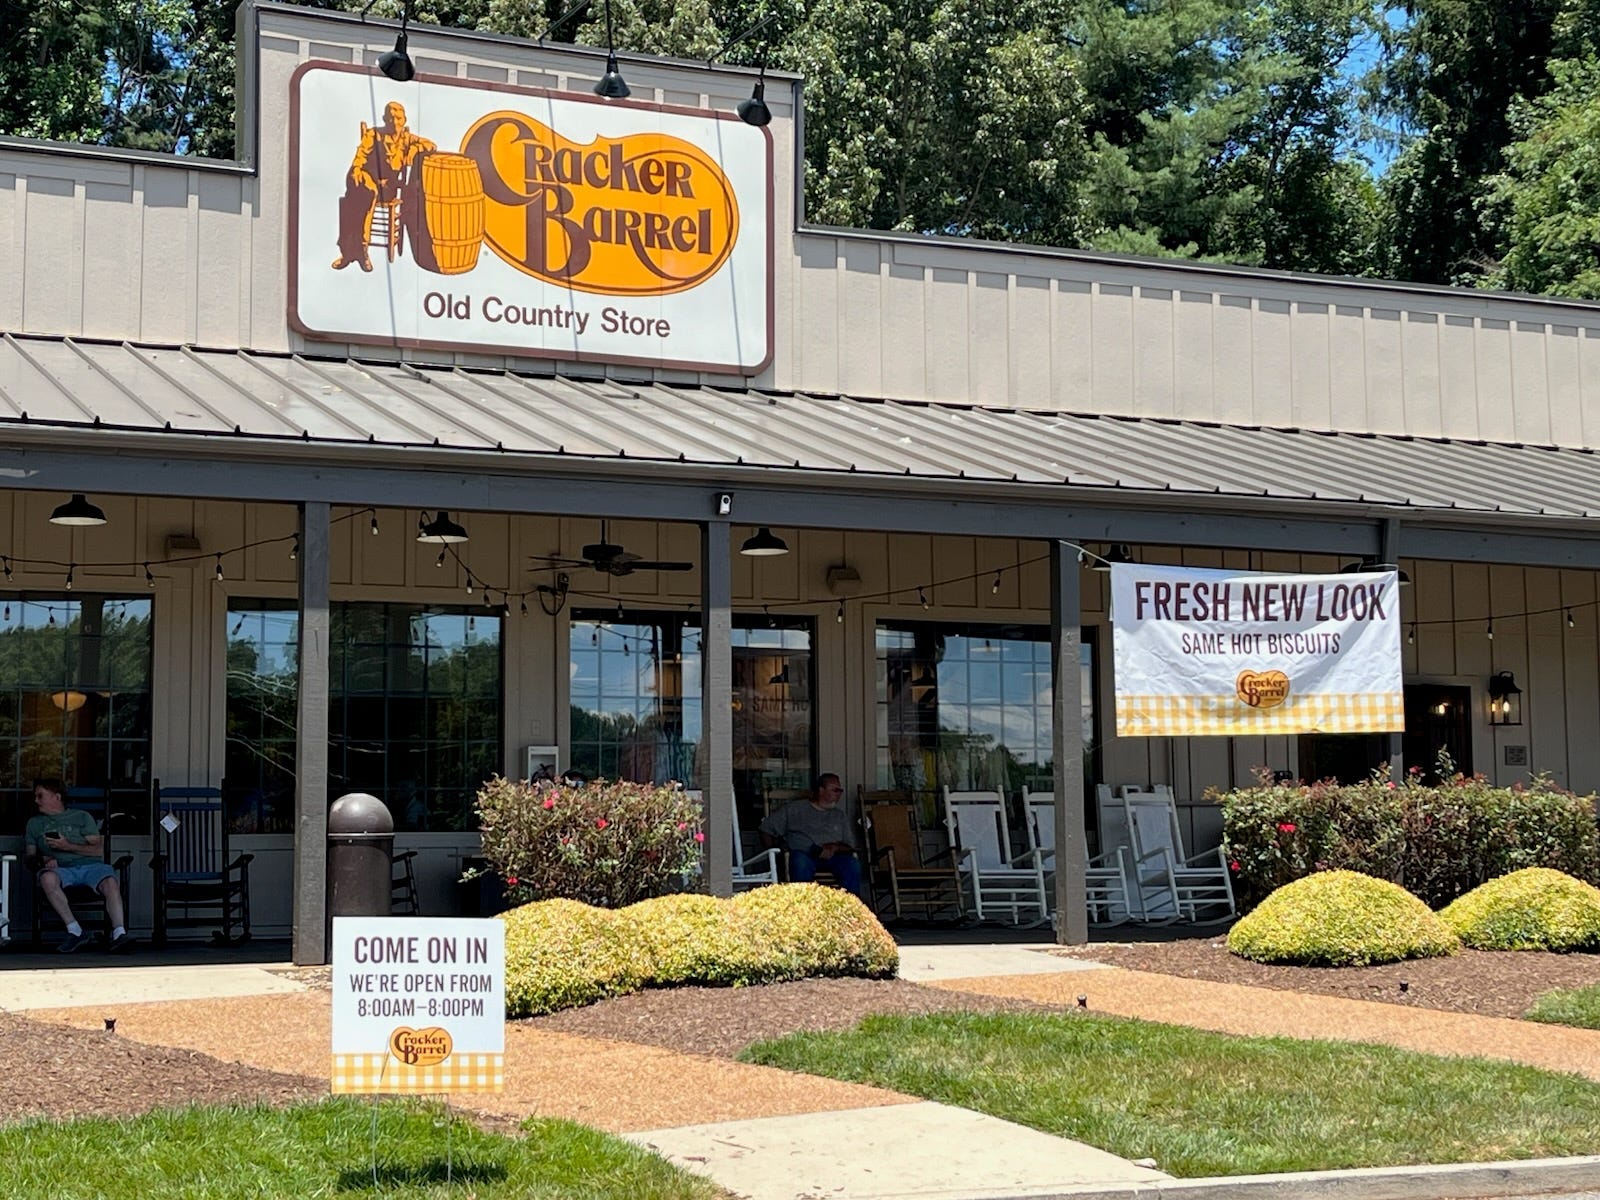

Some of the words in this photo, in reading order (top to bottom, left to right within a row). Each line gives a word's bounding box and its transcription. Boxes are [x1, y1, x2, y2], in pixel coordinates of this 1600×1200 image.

[459, 117, 696, 207] Cracker
[525, 183, 713, 279] Barrel
[424, 292, 471, 320] Old
[482, 297, 590, 335] Country
[601, 307, 671, 338] Store
[1135, 581, 1230, 621] FRESH
[1242, 583, 1308, 622] NEW
[1316, 583, 1386, 622] LOOK
[1182, 632, 1224, 655] SAME
[1232, 633, 1263, 655] HOT
[1268, 632, 1341, 655] BISCUITS
[1240, 674, 1285, 696] Cracker
[1248, 687, 1285, 707] Barrel
[354, 936, 419, 964] COME
[427, 936, 457, 964] ON
[466, 936, 488, 964] IN
[349, 973, 399, 993] WE'RE
[404, 973, 444, 993] OPEN
[450, 973, 492, 993] FROM
[394, 1031, 446, 1053] Cracker
[404, 1044, 447, 1064] Barrel
